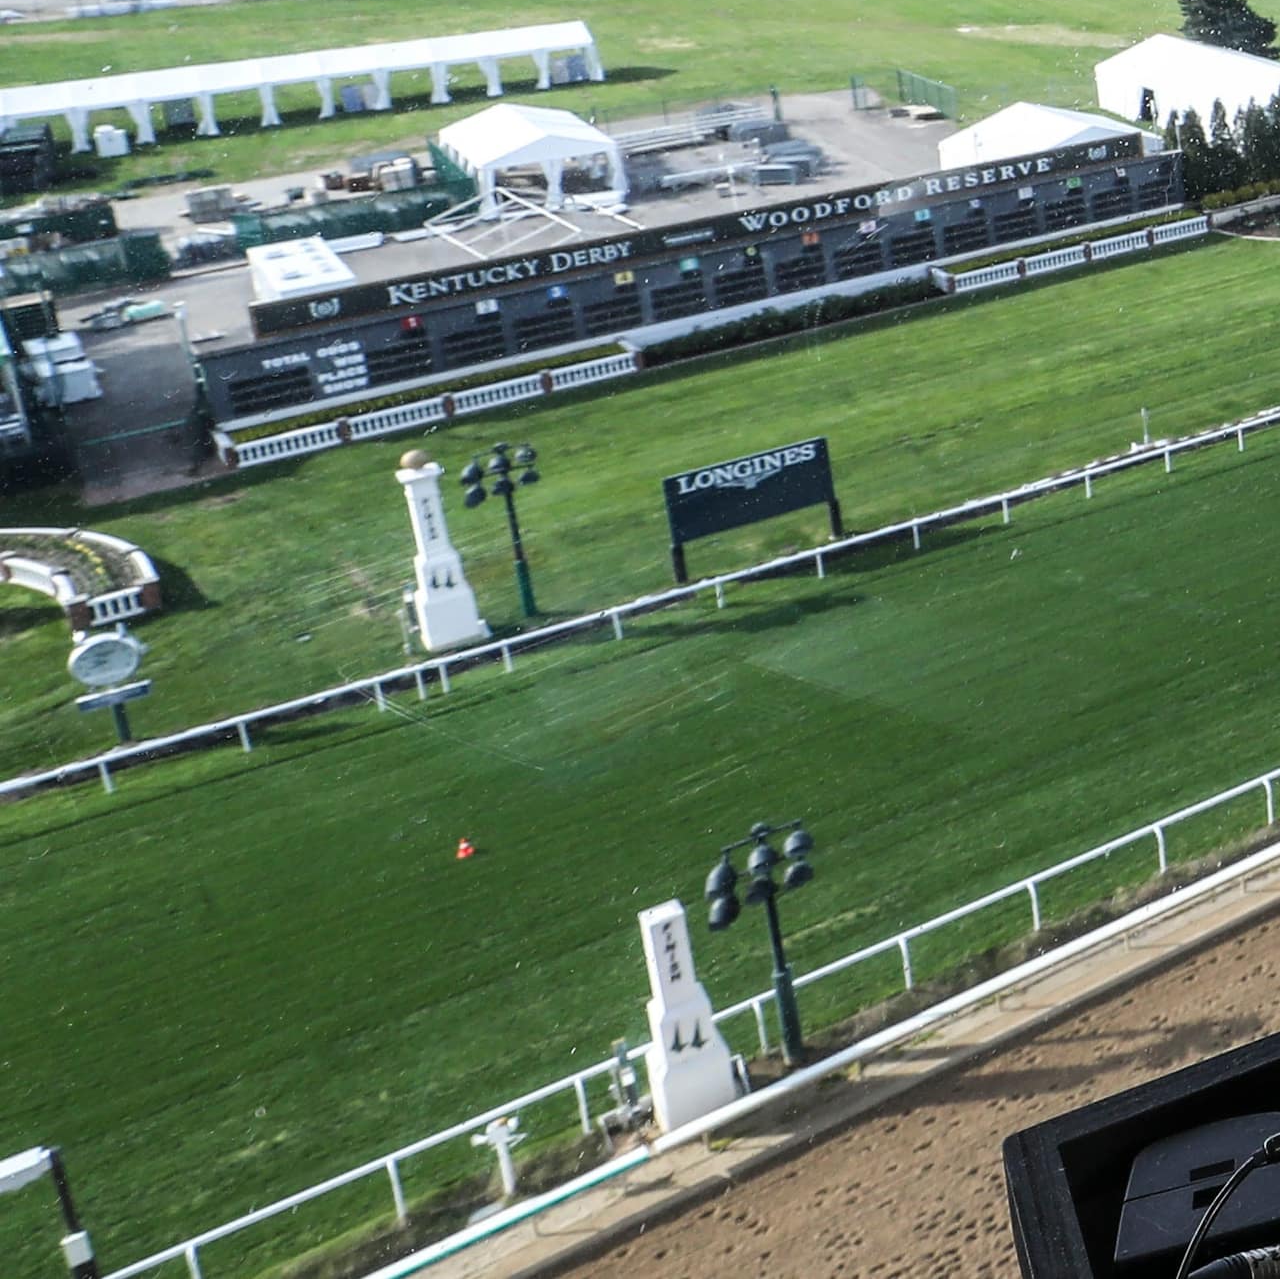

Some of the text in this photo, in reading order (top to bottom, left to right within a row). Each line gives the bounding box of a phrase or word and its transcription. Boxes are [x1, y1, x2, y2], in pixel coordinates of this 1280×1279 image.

[738, 157, 1052, 232] WOODFORD RESERVE
[387, 241, 634, 306] KENTUCKY DERBY
[677, 443, 817, 495] LONGINES
